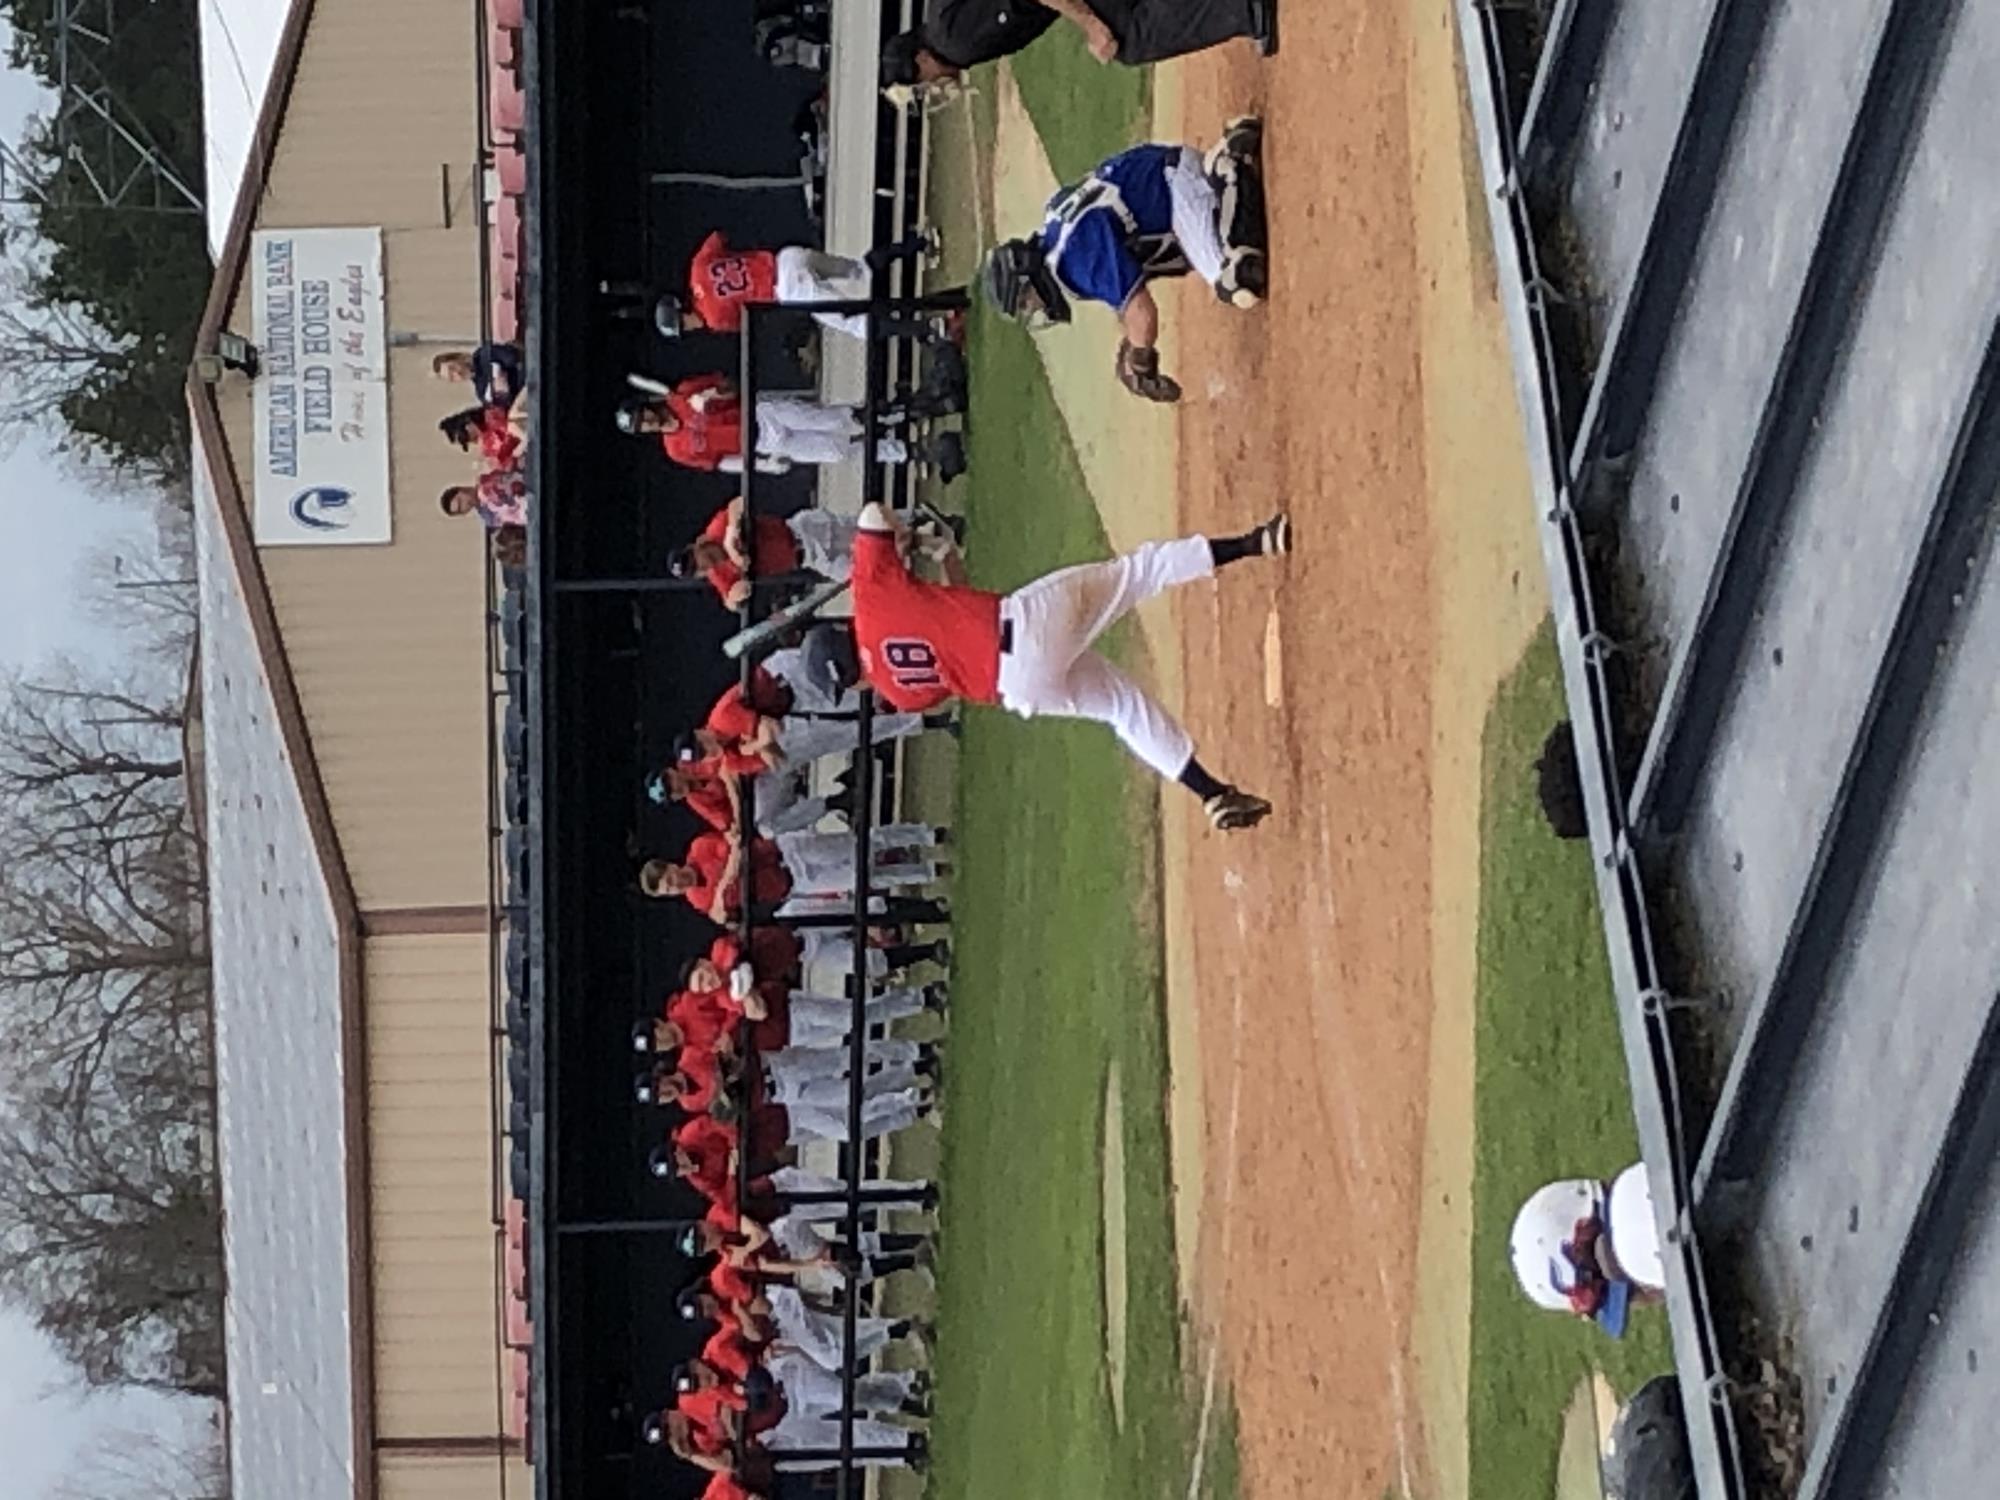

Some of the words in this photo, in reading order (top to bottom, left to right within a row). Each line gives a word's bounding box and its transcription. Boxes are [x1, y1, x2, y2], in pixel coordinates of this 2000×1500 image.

[266, 239, 293, 287] BANK
[302, 280, 330, 355] HOUSE
[336, 265, 372, 324] Eagles
[267, 290, 296, 377] NATIONAL
[340, 332, 365, 356] the
[304, 366, 332, 434] FIELD
[340, 363, 372, 381] of
[269, 384, 297, 477] AMERICAN
[881, 638, 942, 689] 18
